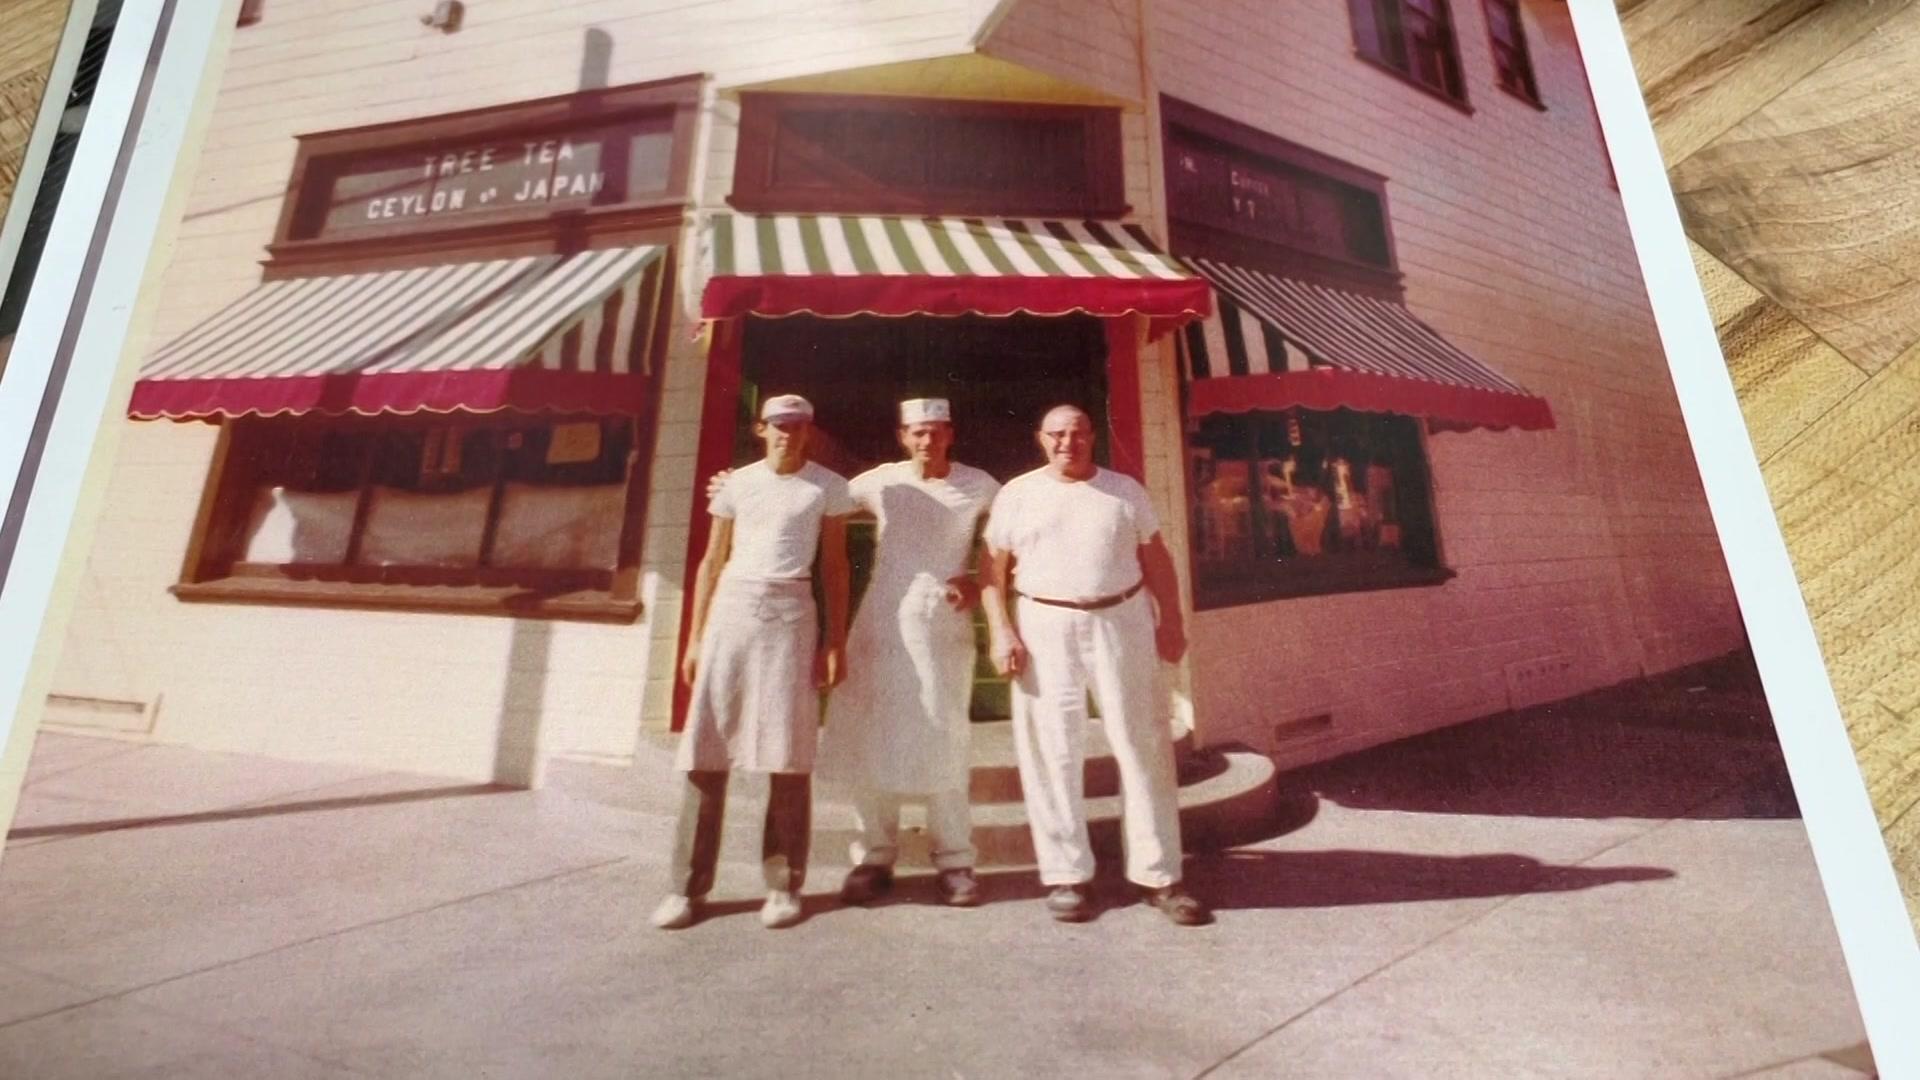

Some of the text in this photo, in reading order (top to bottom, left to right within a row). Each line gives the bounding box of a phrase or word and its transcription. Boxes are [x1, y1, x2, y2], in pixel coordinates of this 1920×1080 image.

[424, 140, 574, 177] TREE TEA
[366, 189, 465, 219] CEYLON
[515, 172, 606, 202] JAPAN
